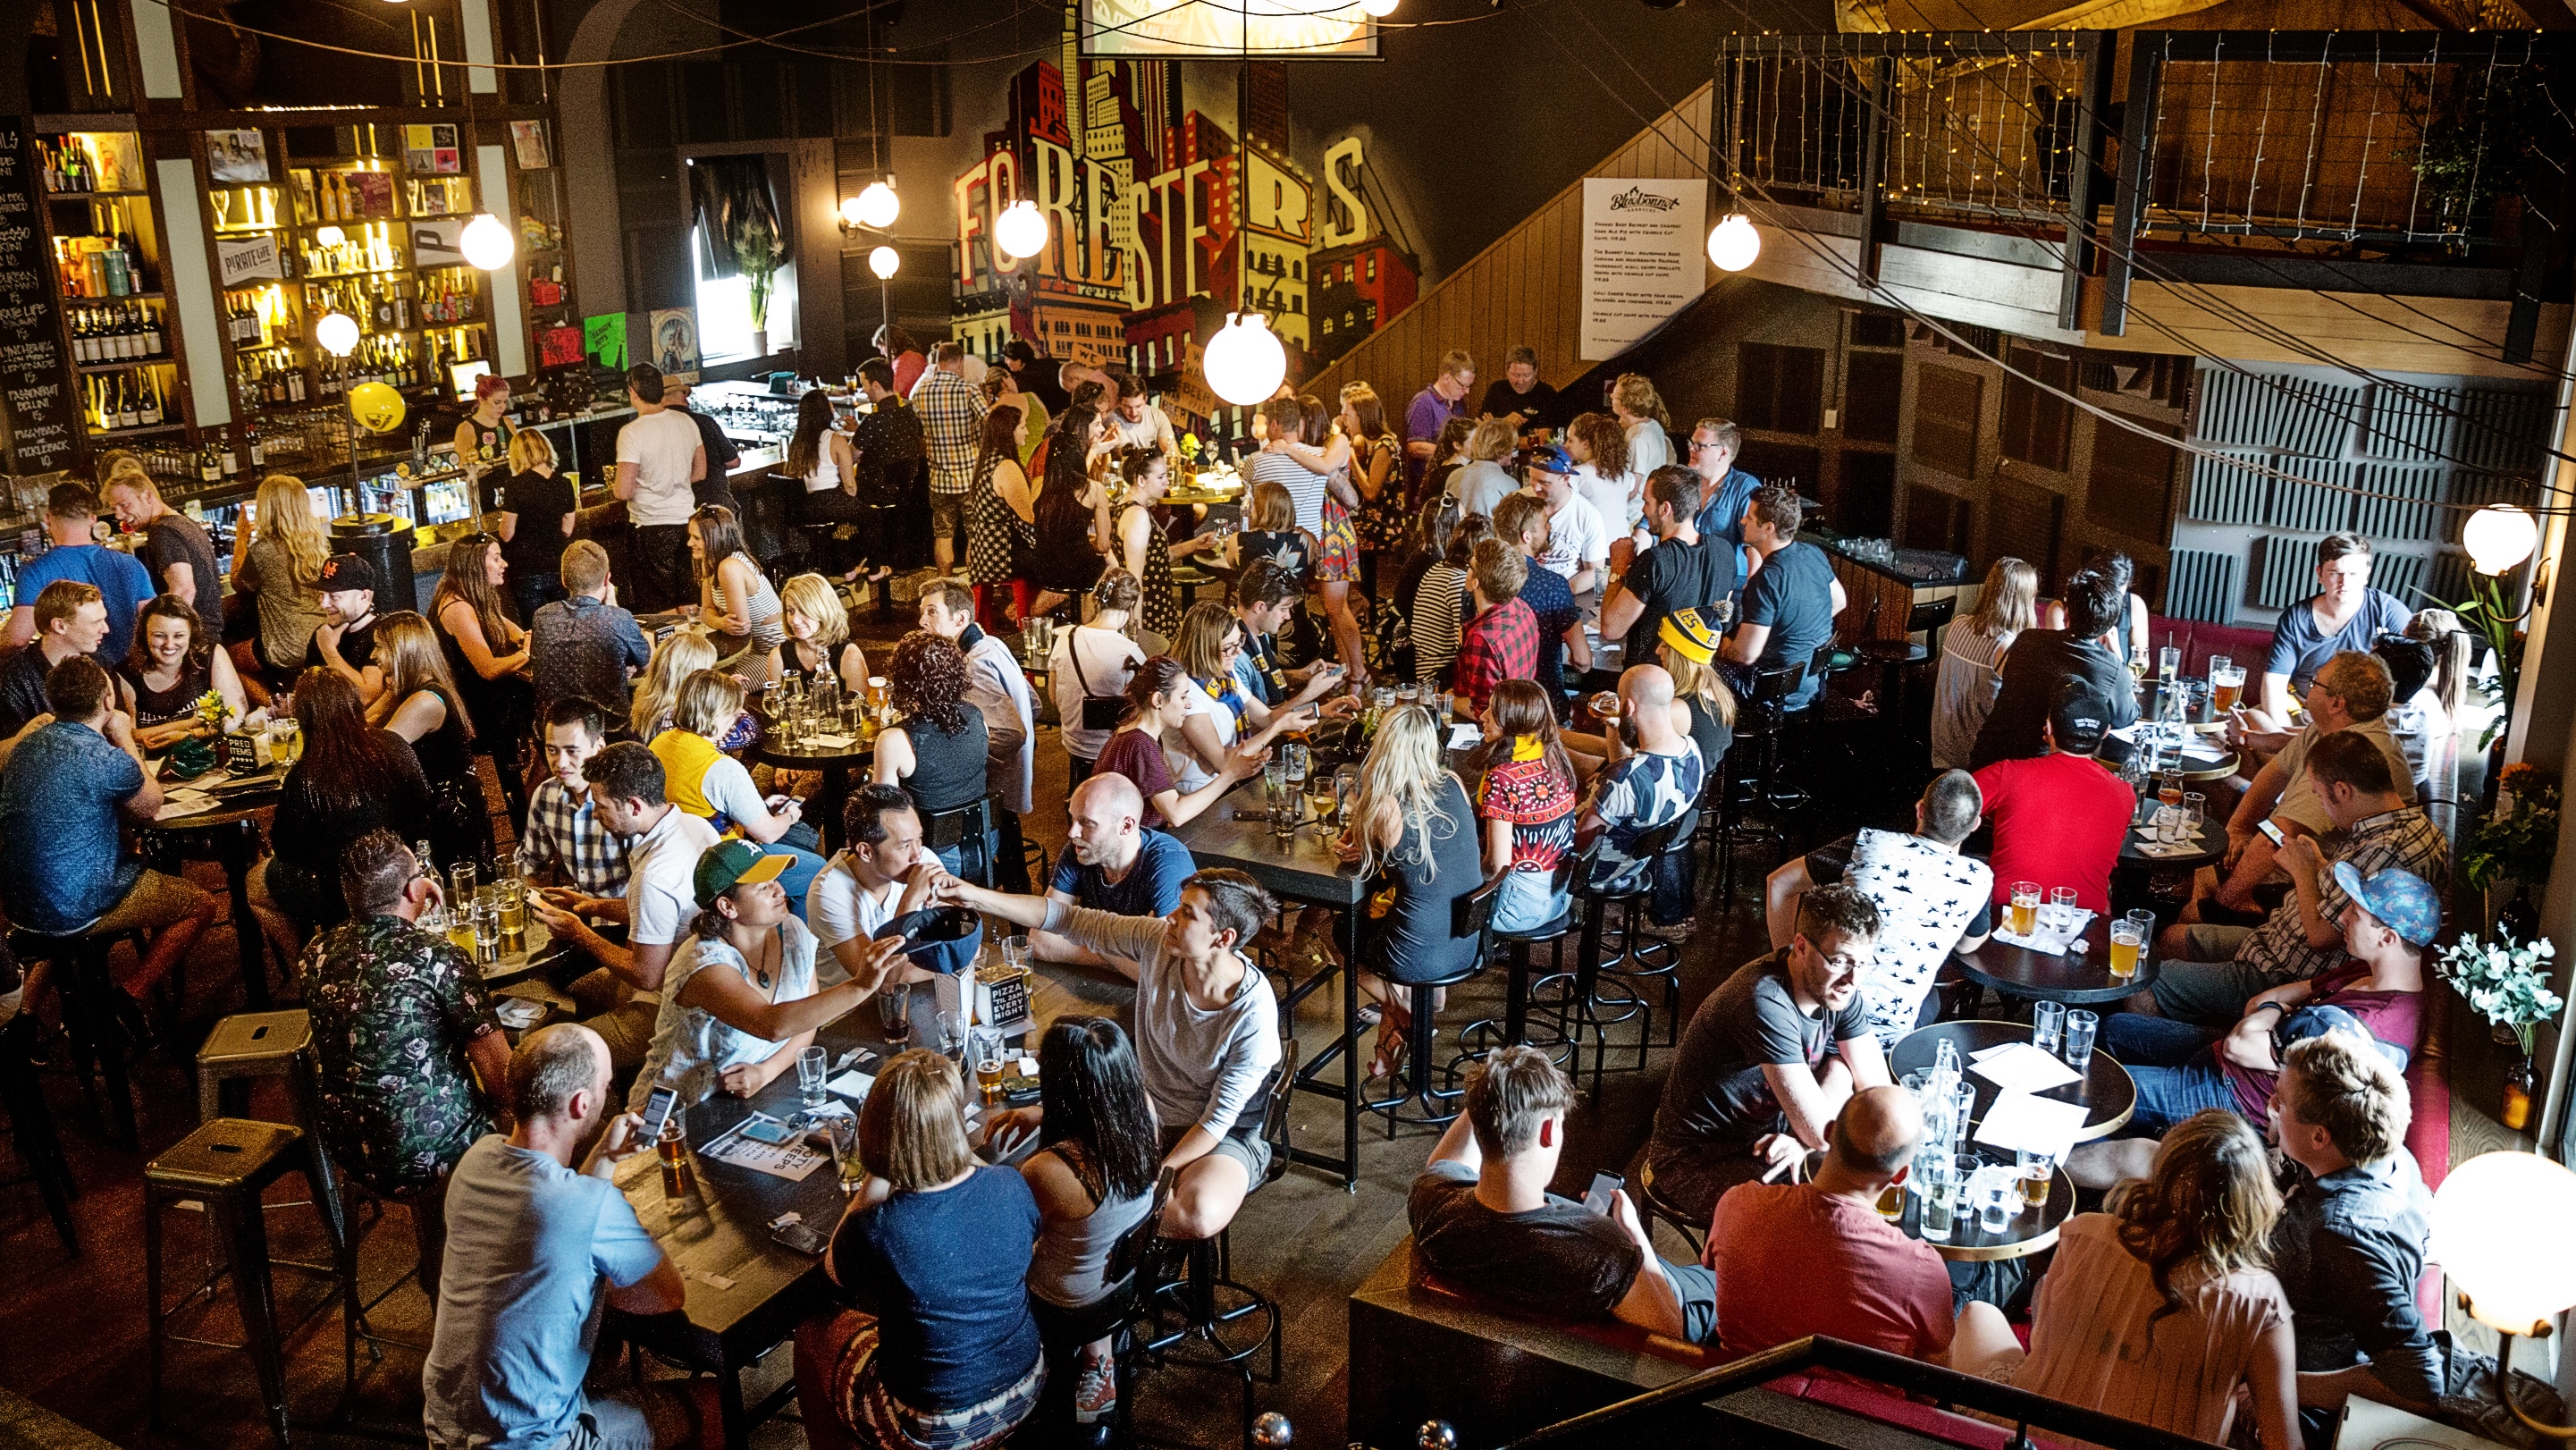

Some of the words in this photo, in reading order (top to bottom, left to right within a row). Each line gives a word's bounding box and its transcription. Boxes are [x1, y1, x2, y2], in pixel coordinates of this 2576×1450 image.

[1610, 191, 1680, 212] Bluebonnet
[955, 136, 1367, 314] FORESTERS
[992, 982, 1023, 999] PIZZA
[1007, 991, 1023, 1001] 2AM
[993, 997, 1023, 1014] EVERY
[994, 1005, 1024, 1021] NIGHT
[774, 1142, 805, 1170] WEEPS
[793, 1151, 814, 1170] OTY
